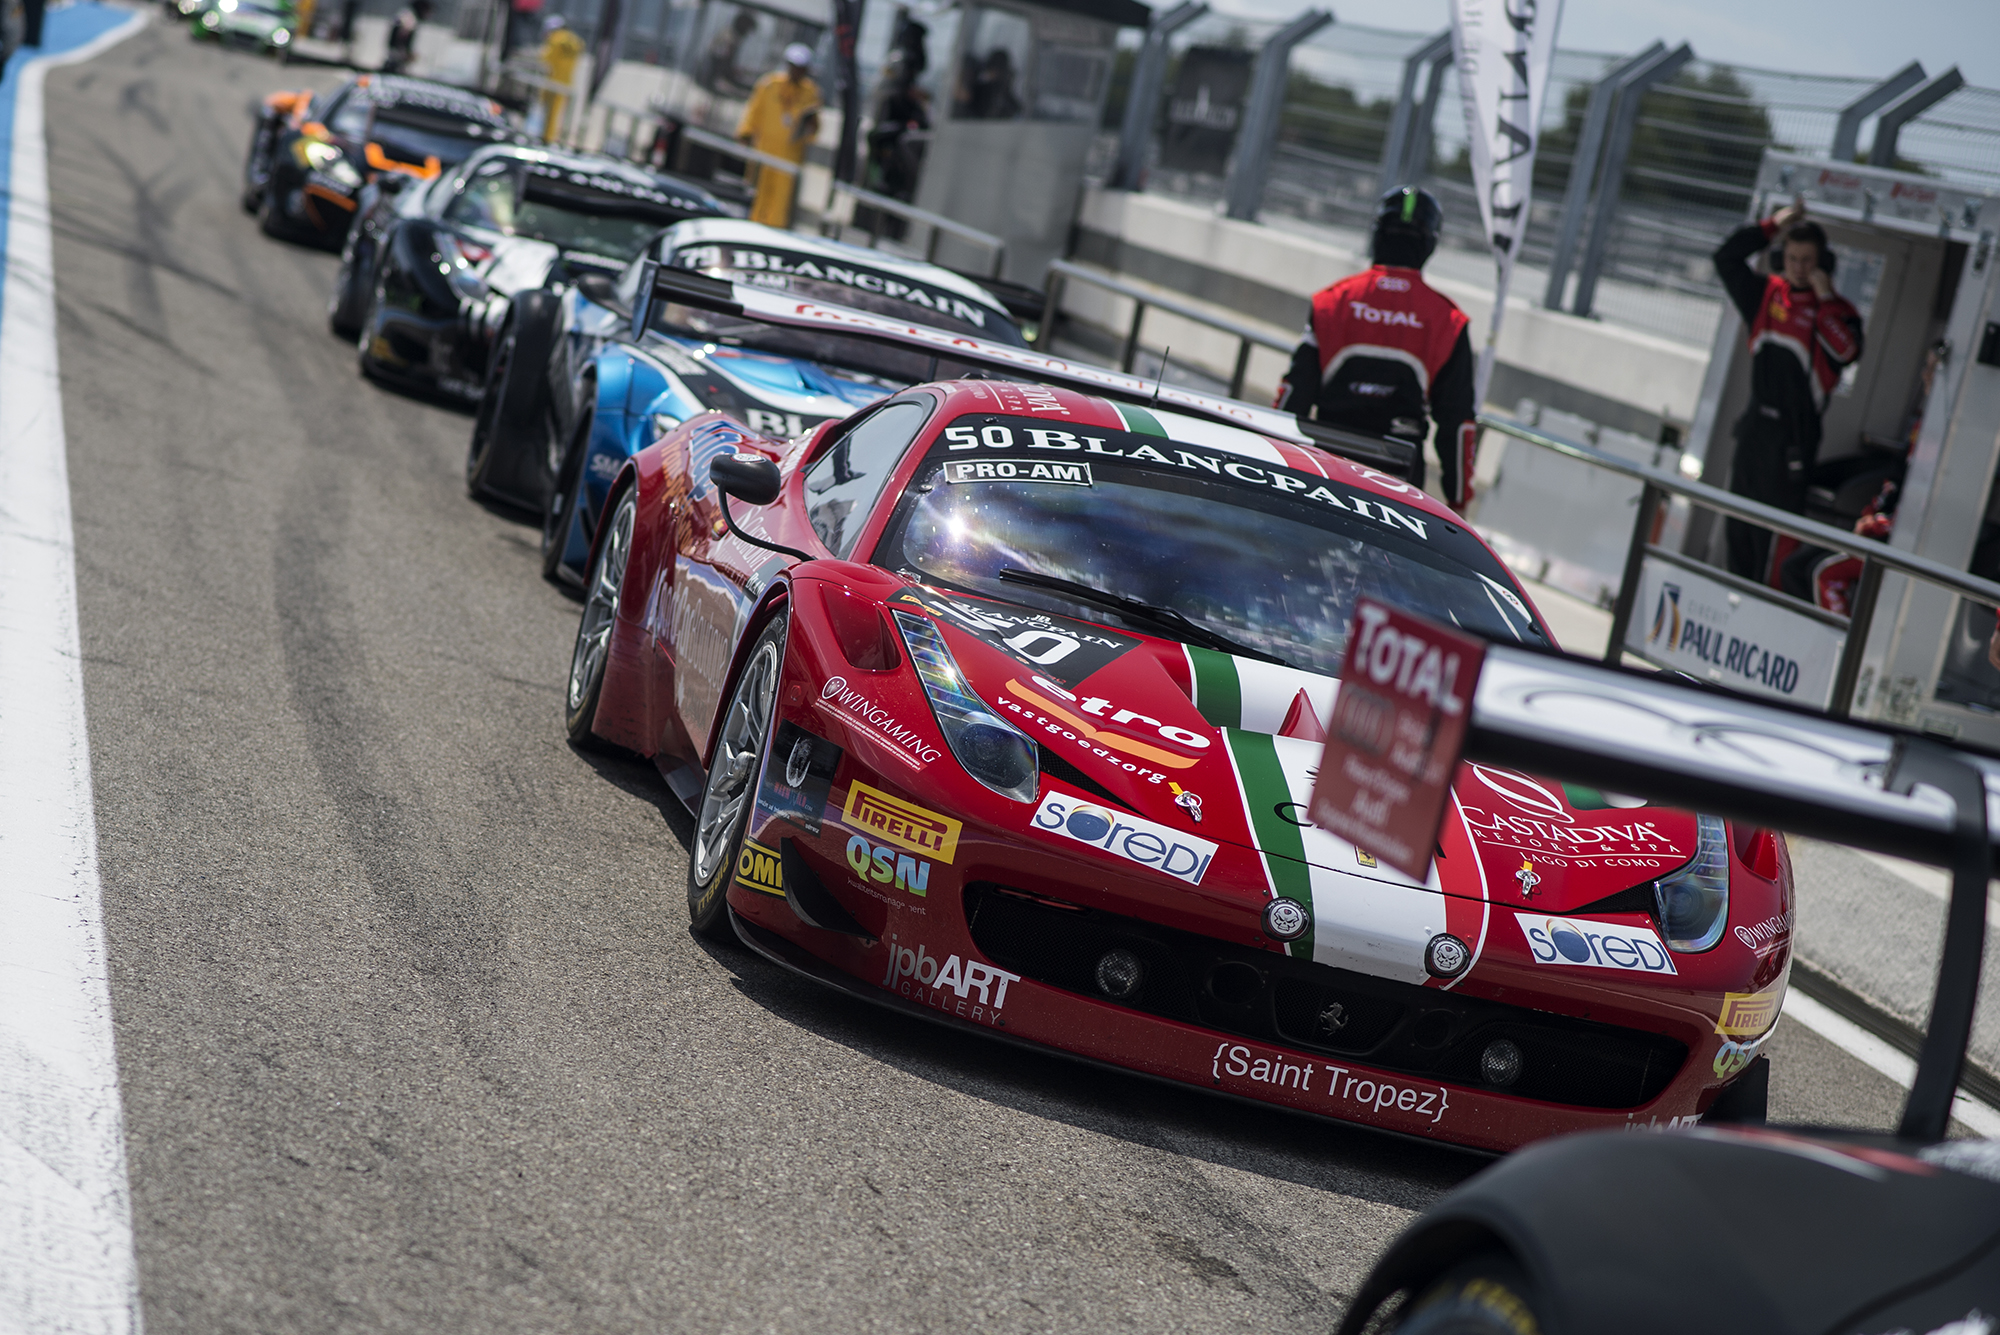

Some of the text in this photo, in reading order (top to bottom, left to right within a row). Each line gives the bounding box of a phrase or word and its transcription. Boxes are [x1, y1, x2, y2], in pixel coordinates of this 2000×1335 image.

[733, 250, 986, 328] BLANCPAIN
[1350, 301, 1423, 328] TOTAL
[944, 426, 1429, 541] 50 BLANCPAIN
[956, 463, 1081, 482] PRO-AM
[1354, 604, 1464, 716] TOTAL
[1680, 619, 1799, 694] PAUL RICARD
[838, 687, 942, 763] WINGAMING
[997, 696, 1167, 784] vastgoedzorg
[1031, 675, 1211, 748] etro
[850, 790, 948, 852] PIRELLI
[1461, 805, 1671, 844] CASTADIVA
[1474, 828, 1681, 853] RESORT & SPA
[846, 835, 931, 897] QSN
[1519, 851, 1661, 868] LAGO DI COMO
[883, 933, 1022, 1010] jpbART
[901, 980, 1001, 1025] GALLERY
[1212, 1043, 1450, 1123] {Saint Tropez}
